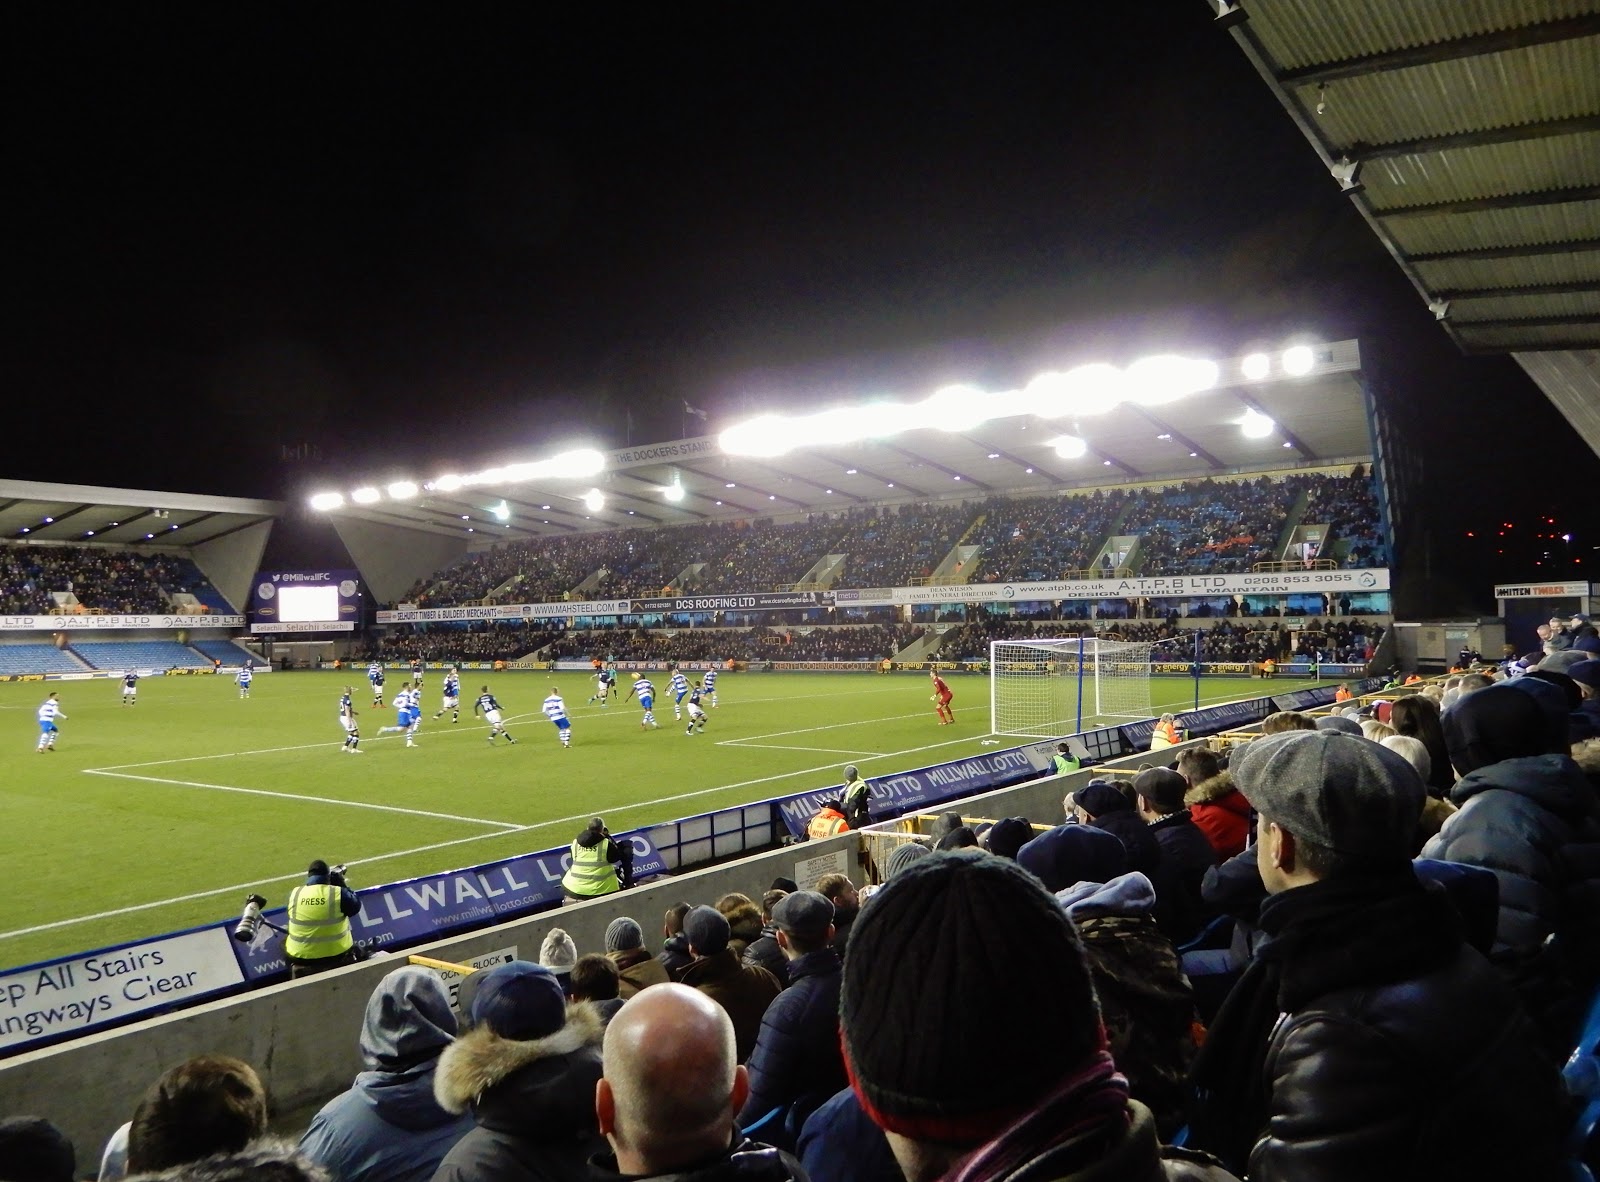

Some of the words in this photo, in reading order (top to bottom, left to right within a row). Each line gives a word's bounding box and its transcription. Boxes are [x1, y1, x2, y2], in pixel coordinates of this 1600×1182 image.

[615, 453, 633, 463] THE
[633, 446, 679, 461] DOCKERS
[680, 441, 713, 455] STAND
[282, 573, 331, 582] @MillwallFC
[1019, 584, 1104, 593] www.atpb.co.uk
[1118, 579, 1184, 590] A.T.P.B
[1191, 577, 1226, 588] LTD
[1244, 577, 1279, 585] 0208
[1315, 574, 1352, 582] 3055
[534, 603, 615, 614] WWW.MAHSTEEL.COM
[676, 600, 694, 610] DCS
[695, 598, 737, 609] ROOFING
[738, 597, 756, 607] LTD
[419, 611, 436, 620] TIMBER
[442, 609, 466, 619] BUILDERS
[466, 608, 497, 618] MERCHANTS
[5, 617, 34, 625] LTD
[68, 616, 120, 625] A.T.P.B
[125, 616, 150, 624] LTD
[174, 616, 220, 624] A.T.P.B
[223, 616, 246, 624] LTD
[286, 623, 320, 631] Selachii
[1217, 664, 1245, 672] energy
[925, 759, 990, 787] MILLWALL
[986, 751, 1028, 773] LOTTO
[300, 897, 326, 906] PRESS
[473, 954, 501, 970] BLOCK
[35, 964, 75, 996] All
[84, 950, 164, 982] Stairs
